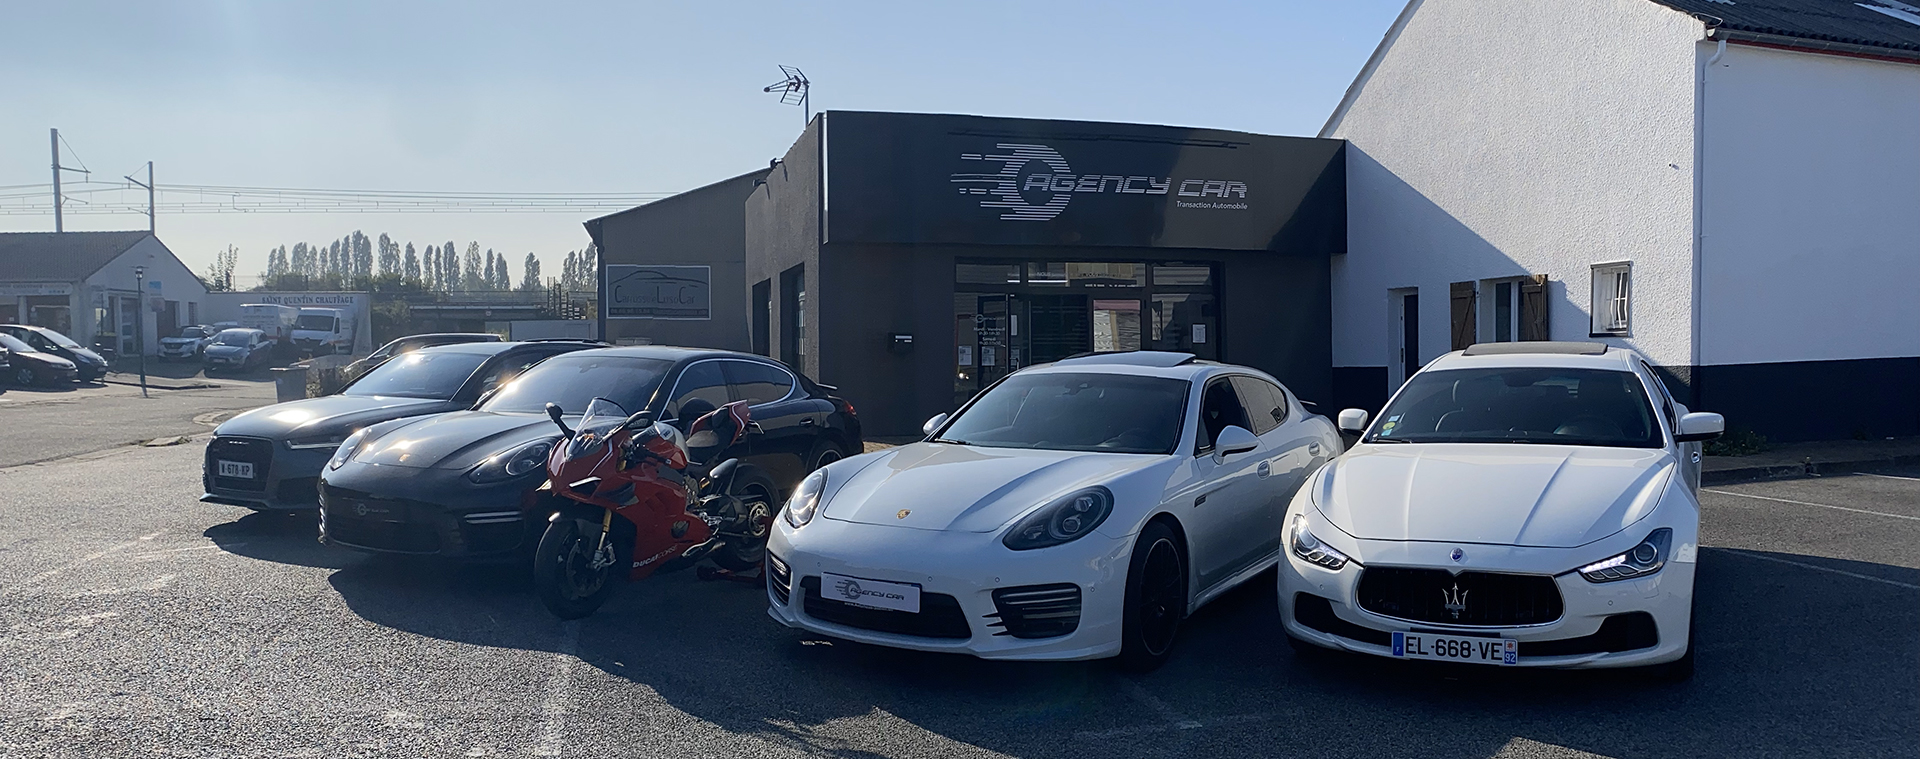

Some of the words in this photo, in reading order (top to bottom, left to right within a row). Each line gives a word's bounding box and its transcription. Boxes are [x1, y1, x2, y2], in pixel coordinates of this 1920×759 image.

[1023, 173, 1171, 195] AGENCY
[1178, 179, 1248, 198] CAR
[1176, 200, 1211, 208] Transaction
[1212, 202, 1248, 210] Automobile
[262, 295, 281, 304] SAINT
[284, 295, 313, 305] QUENTIN
[316, 295, 354, 304] CHAUFFAGE
[633, 553, 659, 568] DUCATI
[850, 587, 885, 598] AGENCY
[886, 593, 905, 601] CAR
[1406, 636, 1503, 661] EL-668-VE
[1505, 653, 1516, 663] 92
